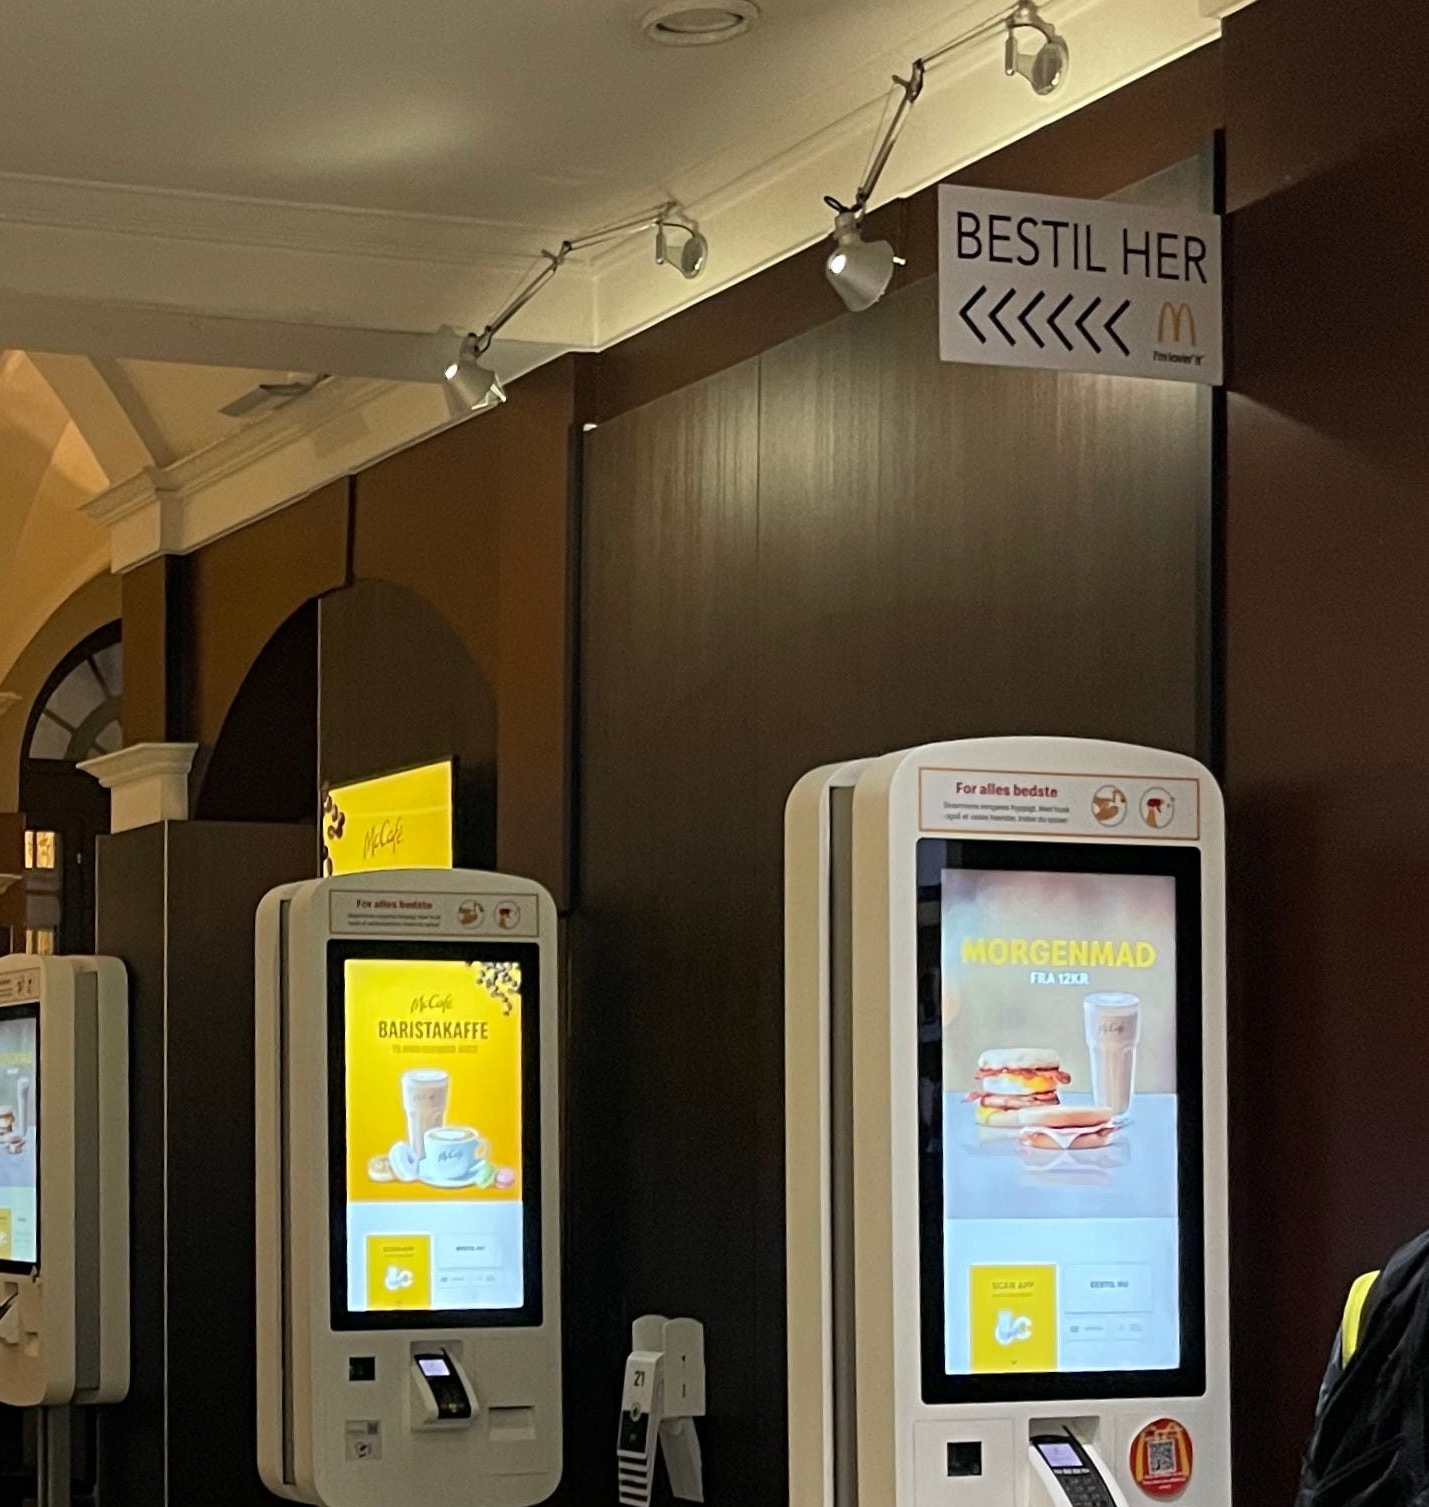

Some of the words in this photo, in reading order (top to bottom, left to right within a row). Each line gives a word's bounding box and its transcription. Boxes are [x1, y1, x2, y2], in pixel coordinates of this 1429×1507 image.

[957, 211, 1106, 273] BESTIL
[1123, 228, 1208, 284] HER
[956, 782, 977, 794] For
[980, 783, 1010, 796] alles
[1013, 784, 1058, 798] bedste
[961, 938, 1157, 968] MORGENMAD
[1030, 971, 1055, 985] FRA
[1058, 972, 1090, 985] 12KR
[378, 1020, 489, 1039] BARISTAKAFFE
[633, 1370, 646, 1387] 21
